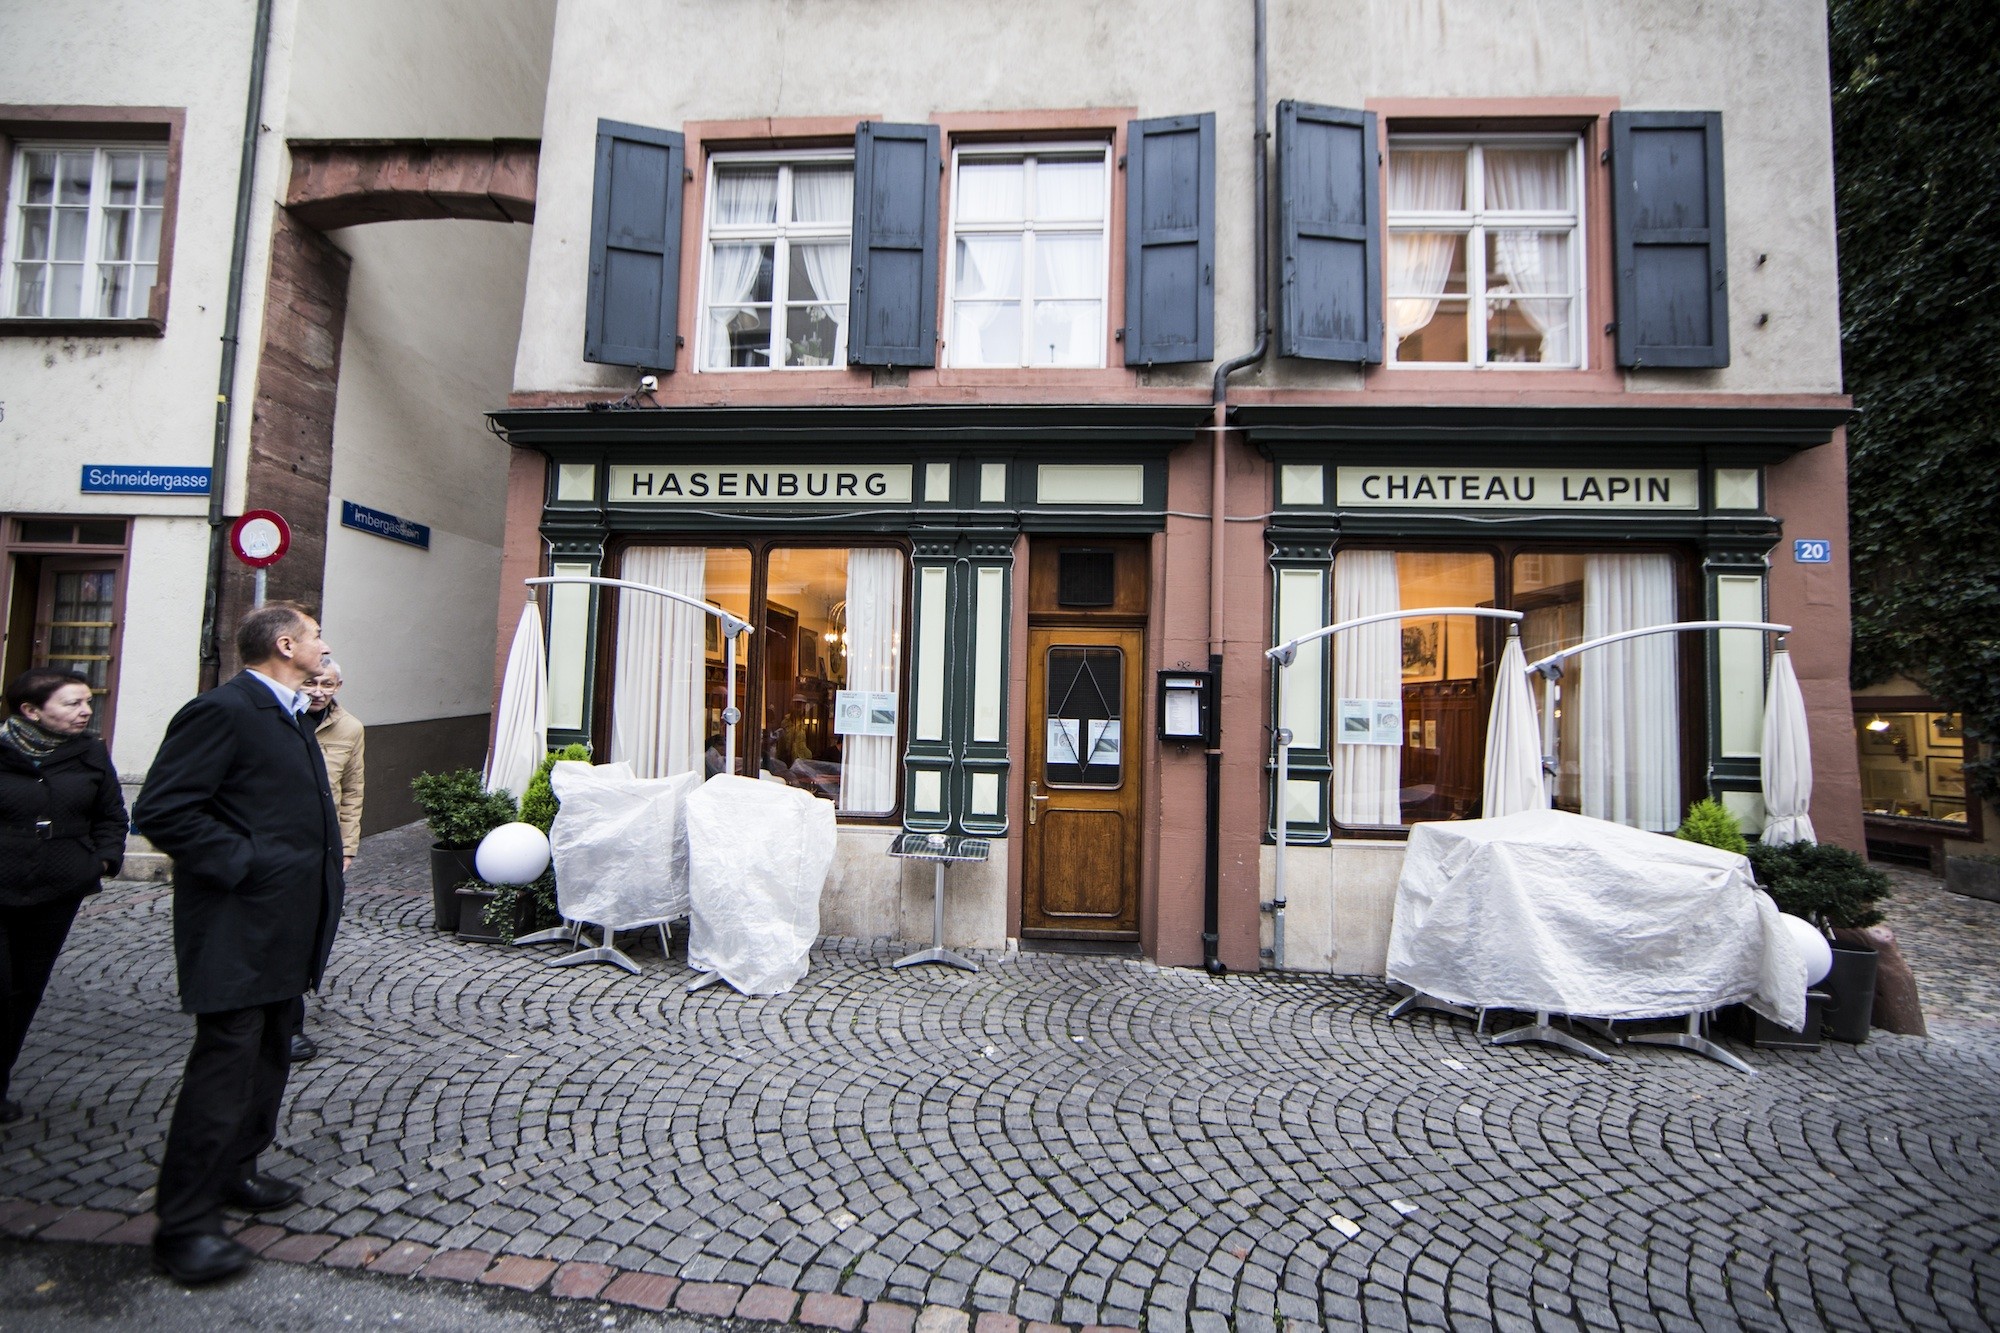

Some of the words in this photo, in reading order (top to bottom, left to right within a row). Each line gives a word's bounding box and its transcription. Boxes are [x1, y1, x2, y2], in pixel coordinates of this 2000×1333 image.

[89, 468, 208, 491] Schneidergasse
[632, 472, 887, 497] HASENBURG
[1361, 474, 1536, 500] CHATEAU
[1562, 476, 1670, 502] LAPIN
[1801, 543, 1824, 559] 20
